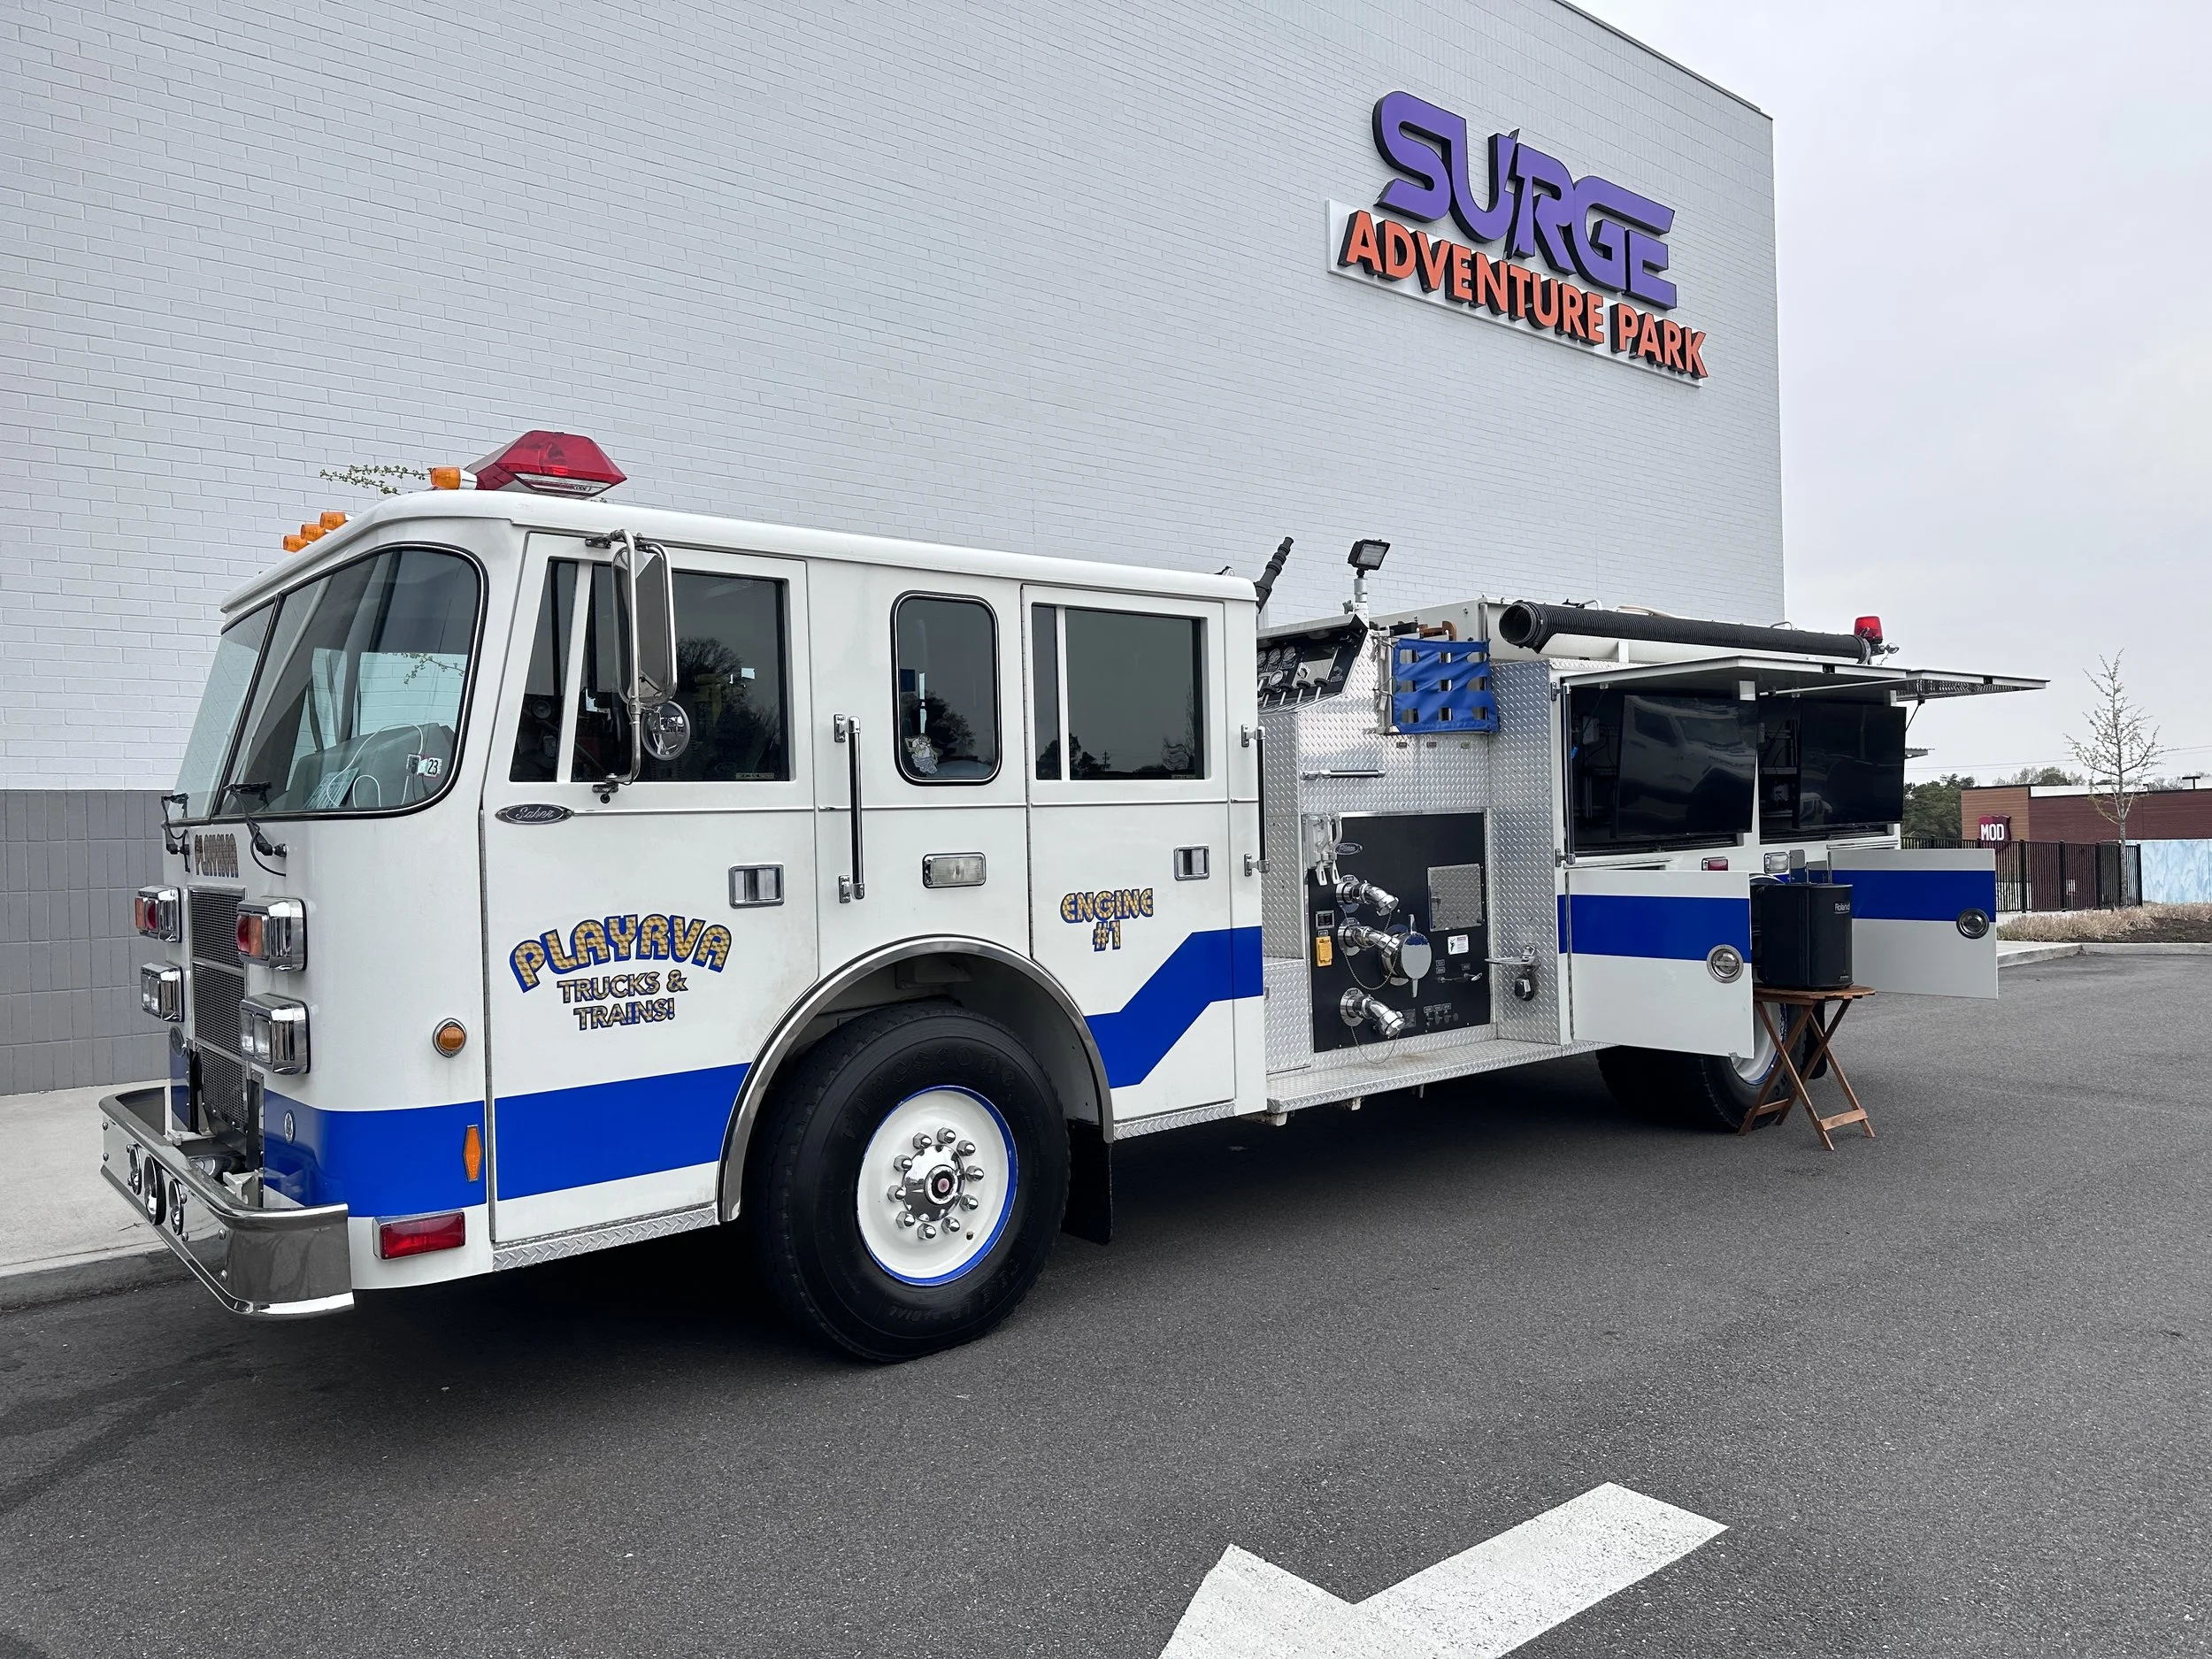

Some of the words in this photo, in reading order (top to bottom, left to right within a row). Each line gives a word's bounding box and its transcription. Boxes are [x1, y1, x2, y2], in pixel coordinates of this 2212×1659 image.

[1372, 91, 1677, 310] SURGE
[1338, 210, 1605, 346] ADVENTURE
[1609, 303, 1709, 379] PARK
[427, 758, 439, 775] 23
[515, 805, 555, 819] Saber
[1980, 823, 2005, 841] MOD
[1060, 887, 1154, 924] ENGINE
[1834, 902, 1851, 911] Roland
[1092, 919, 1121, 952] #1
[509, 913, 733, 994] PLAYRVA
[557, 971, 661, 1004] TRUCKS
[665, 969, 689, 993] &
[573, 997, 676, 1032] TRAINS!
